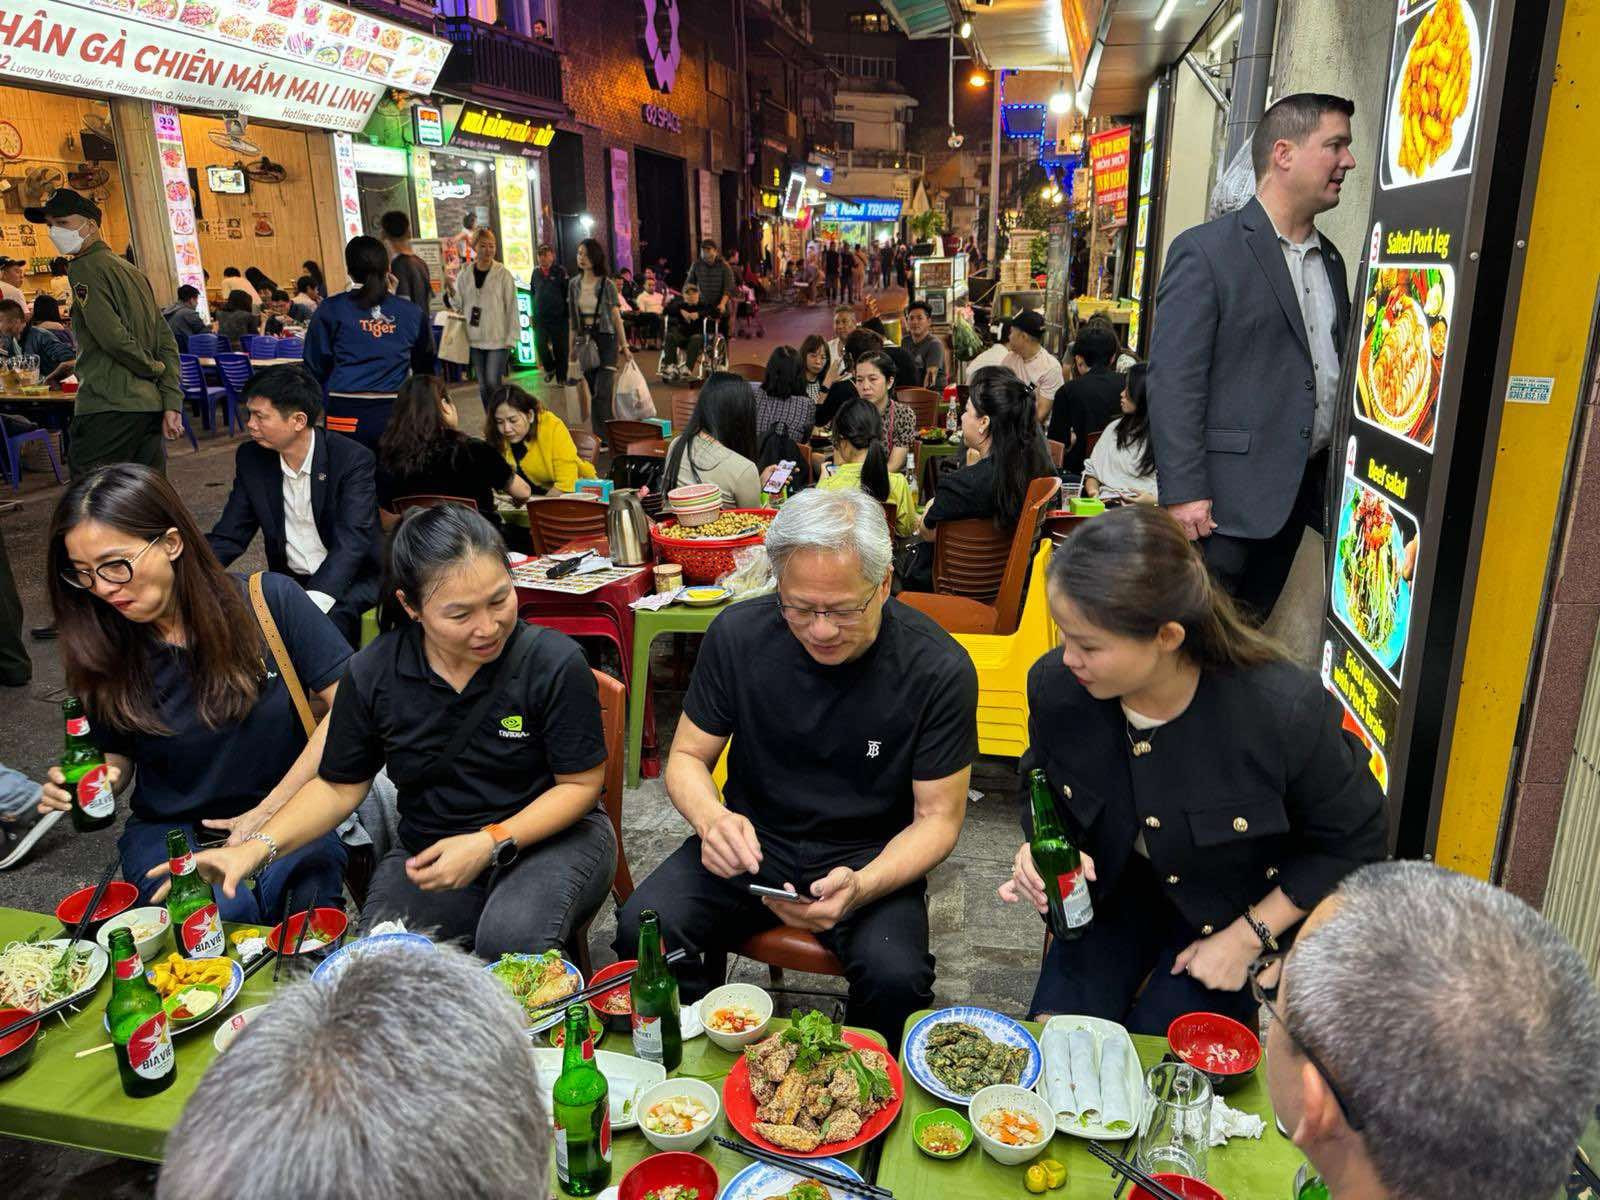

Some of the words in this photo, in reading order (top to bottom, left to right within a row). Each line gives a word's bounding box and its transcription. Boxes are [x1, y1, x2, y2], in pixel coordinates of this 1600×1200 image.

[80, 29, 127, 68] GÀ
[134, 45, 224, 86] CHIÊN
[222, 62, 286, 98] MẮM
[284, 77, 329, 106] MAI
[327, 85, 376, 114] LINH
[281, 107, 313, 121] Hotline:
[867, 202, 899, 216] TRUNG
[1387, 229, 1413, 254] Salted
[1412, 228, 1434, 254] Pork
[1433, 227, 1450, 259] leg
[360, 319, 396, 338] Tiger
[1368, 458, 1387, 486] Beef
[1385, 471, 1408, 500] salad
[195, 941, 211, 953] BIA
[142, 1055, 160, 1070] BIA
